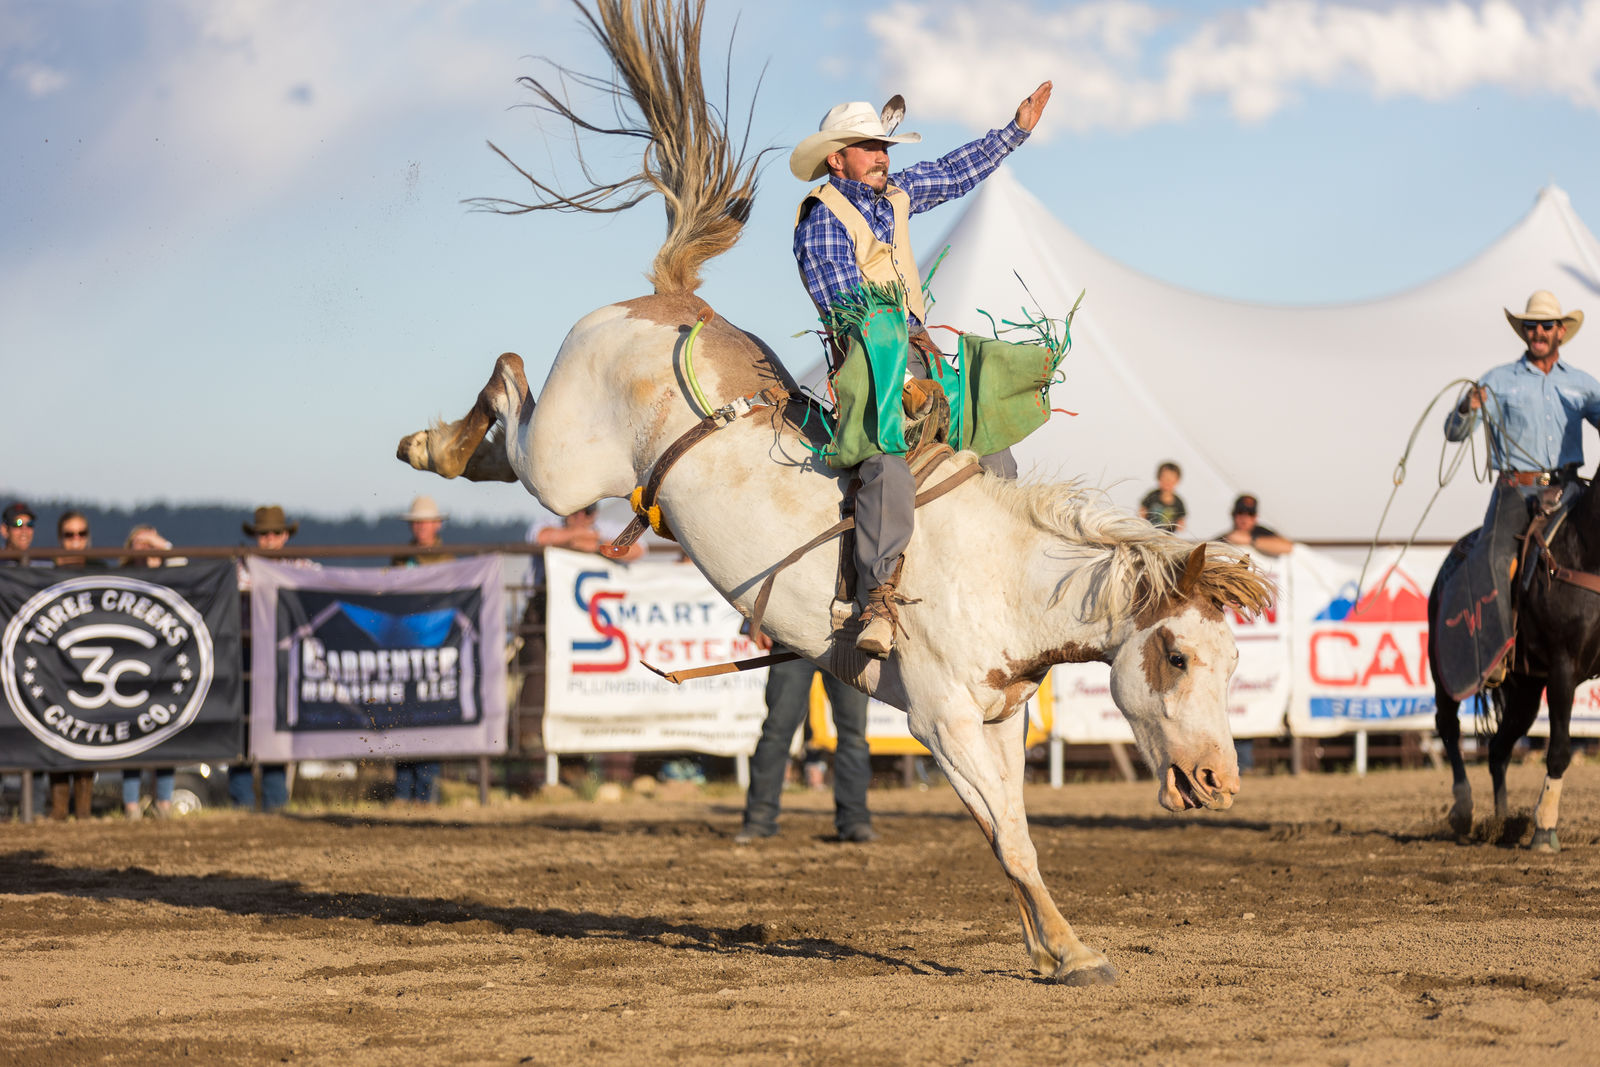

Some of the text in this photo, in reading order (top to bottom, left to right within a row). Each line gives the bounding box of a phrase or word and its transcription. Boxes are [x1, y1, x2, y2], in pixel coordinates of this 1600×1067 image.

[26, 590, 189, 647] THREE CREEKS
[571, 571, 717, 651] SMART
[571, 590, 770, 674] SYSTEM
[67, 646, 151, 709] 3C
[567, 678, 669, 696] PLUMBING
[690, 676, 766, 692] HEATIN
[43, 703, 178, 744] CATTLE CO.
[1333, 698, 1466, 719] SERVIC
